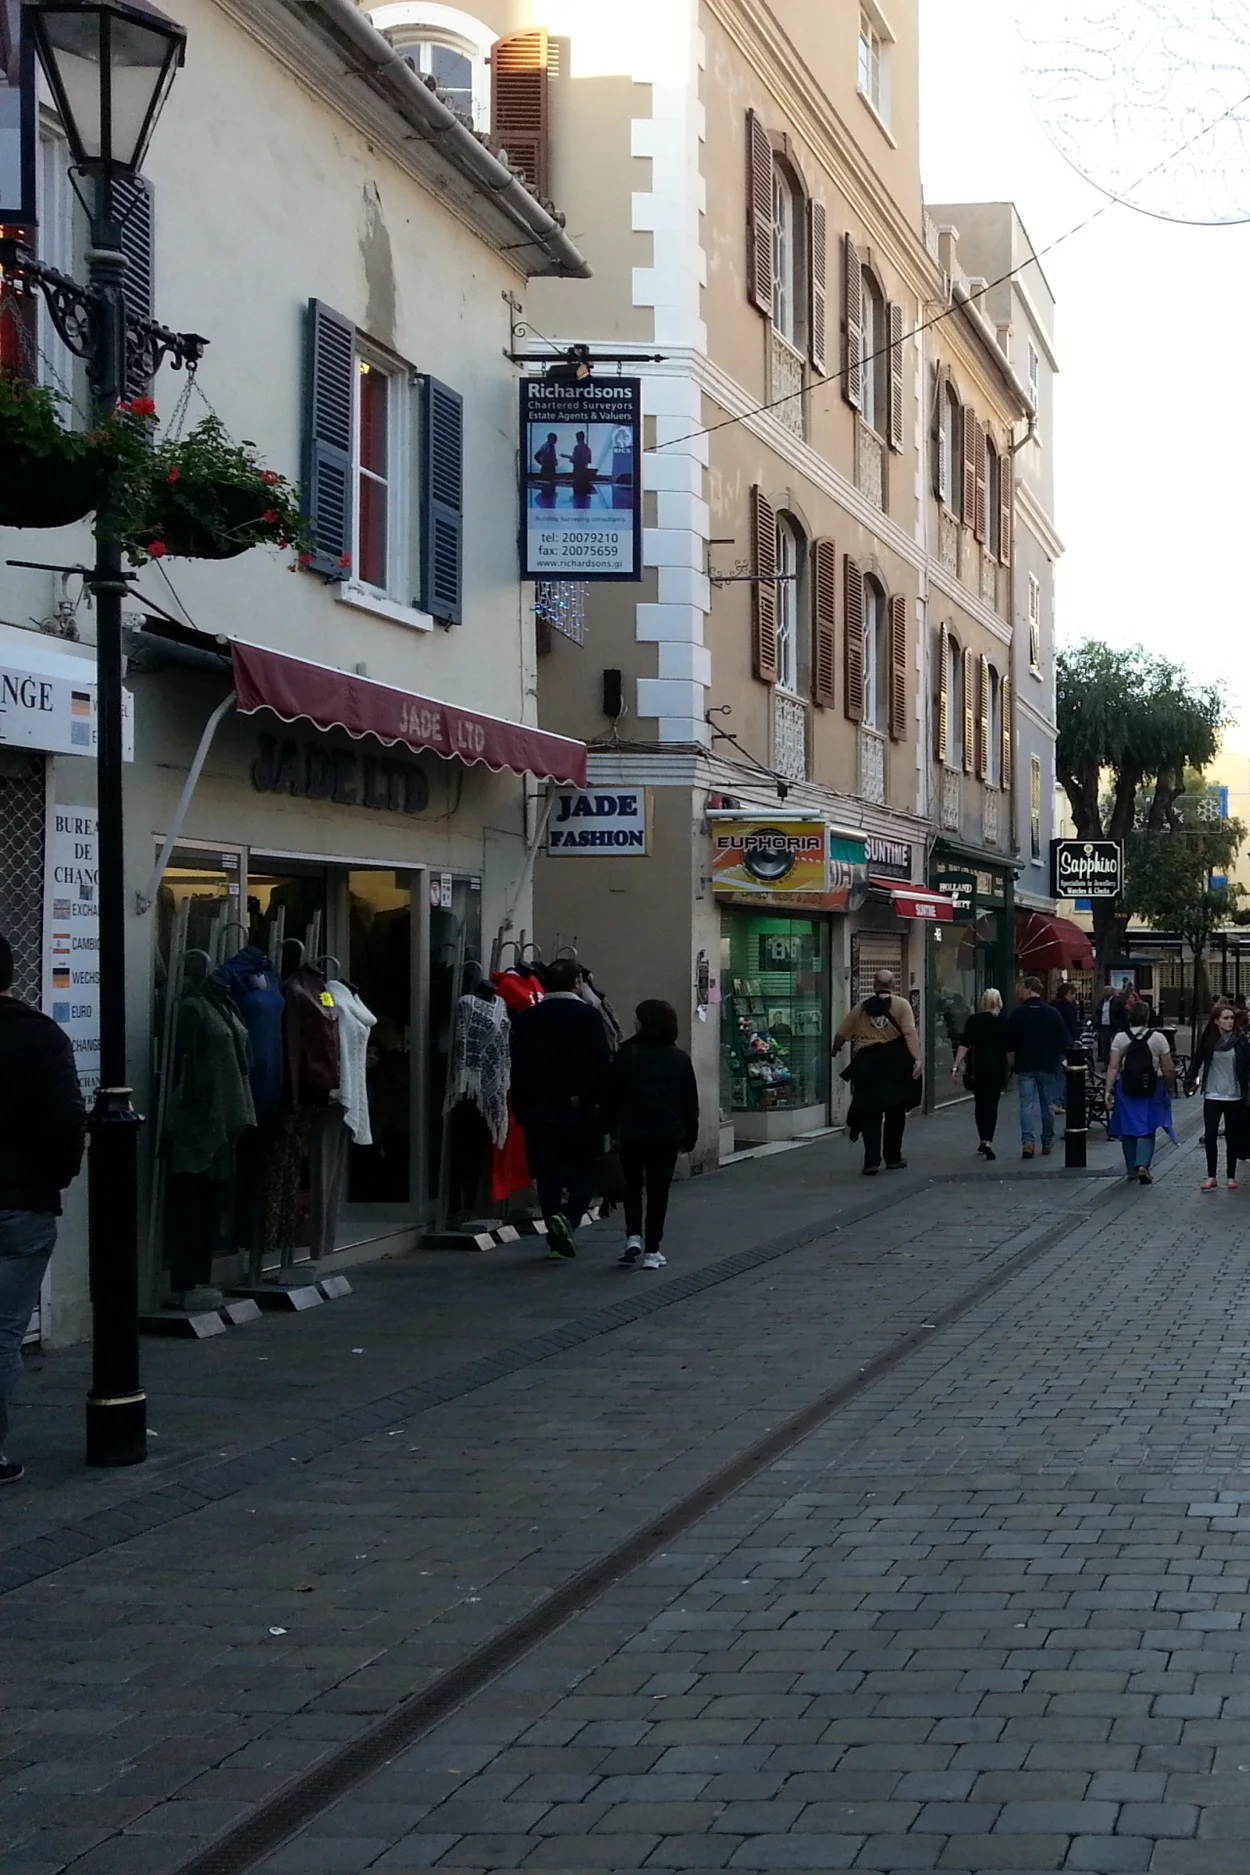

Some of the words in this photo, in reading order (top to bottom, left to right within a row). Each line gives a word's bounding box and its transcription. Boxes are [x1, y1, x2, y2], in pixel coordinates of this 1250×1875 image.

[527, 383, 633, 399] Richardsons
[527, 401, 580, 410] Chartered
[582, 401, 633, 412] Surveyors
[528, 412, 556, 420] Estate
[558, 412, 589, 421] Agents
[590, 412, 598, 420] &
[599, 412, 632, 420] Valuers
[541, 532, 559, 543] tel:
[562, 532, 619, 543] 20079210
[538, 545, 559, 556] fax:
[562, 545, 619, 557] 20075659
[536, 560, 623, 569] www.richardsons.gi
[399, 701, 443, 741] JADE
[457, 719, 486, 753] LTD
[251, 731, 358, 805] JADE
[363, 752, 430, 814] LTD
[556, 795, 638, 822] JADE
[55, 815, 99, 836] BURE
[550, 829, 644, 847] FASHION
[717, 836, 821, 851] EUPHORIA
[74, 842, 93, 860] DE
[864, 837, 909, 867] SUNTIME
[1060, 851, 1117, 880] Sapphiro
[939, 882, 973, 894] HOLLAND
[72, 971, 100, 985] WECHS
[71, 1005, 93, 1019] EURO
